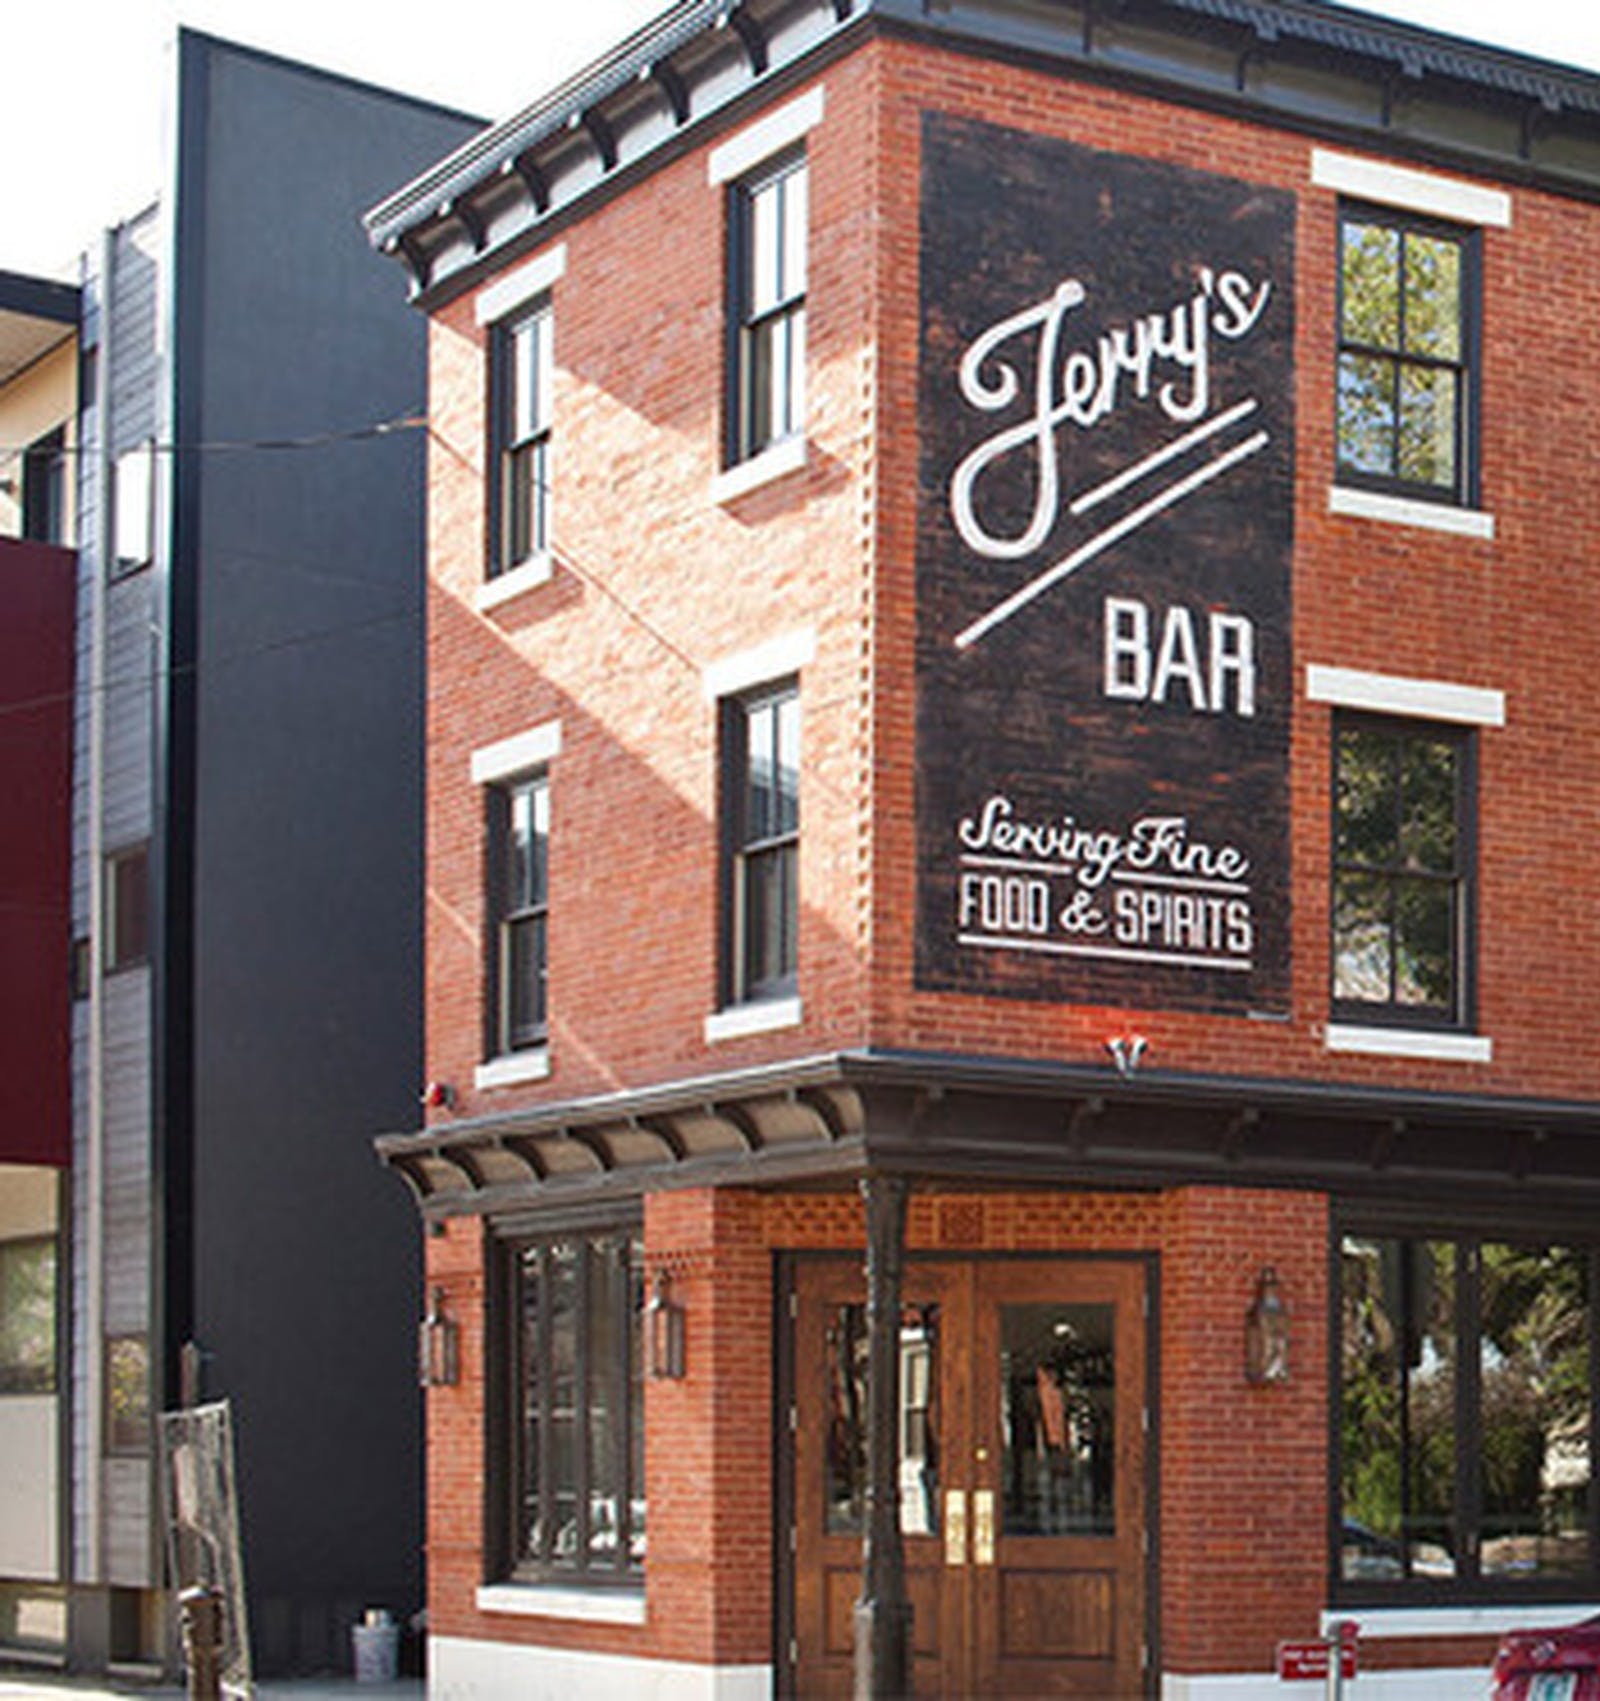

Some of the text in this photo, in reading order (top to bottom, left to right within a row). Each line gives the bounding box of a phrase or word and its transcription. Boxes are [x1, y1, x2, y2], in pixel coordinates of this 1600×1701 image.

[951, 267, 1271, 558] Jerry's
[1105, 597, 1256, 717] BAR
[959, 796, 1250, 886] Serving Fine
[960, 874, 1253, 952] FOOD & SPIRITS
